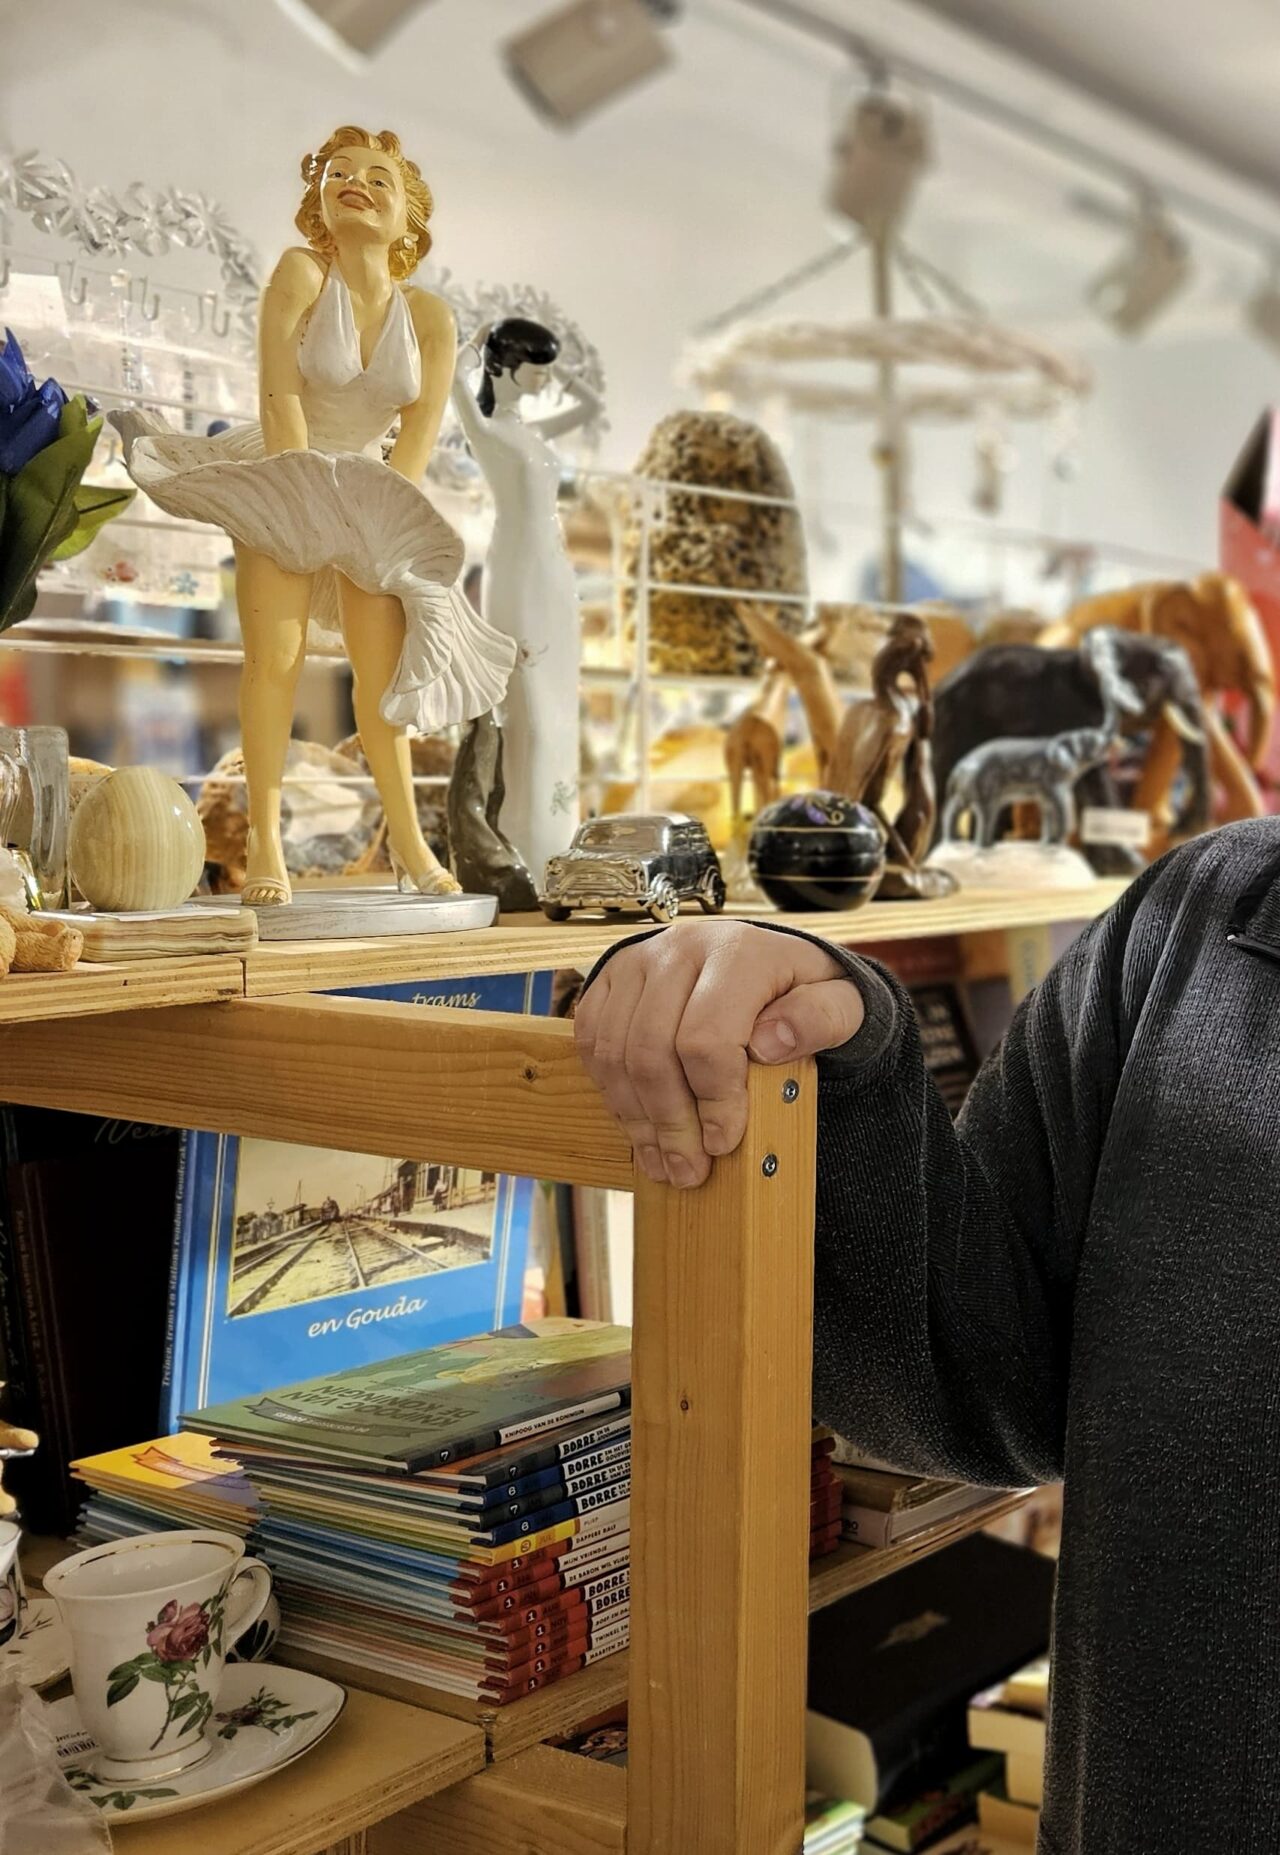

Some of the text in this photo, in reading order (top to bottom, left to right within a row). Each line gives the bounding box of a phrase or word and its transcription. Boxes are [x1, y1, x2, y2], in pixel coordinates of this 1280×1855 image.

[412, 992, 481, 1008] trams
[173, 1203, 183, 1245] rondom
[169, 1246, 179, 1289] stations
[166, 1309, 175, 1340] trams
[308, 1295, 428, 1339] en Gouda
[280, 1390, 339, 1408] VAN
[341, 1402, 457, 1428] KNIPOOG
[440, 1450, 449, 1461] 7
[504, 1426, 533, 1438] KNIPOOG
[534, 1421, 546, 1429] VAN
[509, 1466, 517, 1476] 7
[562, 1433, 595, 1455] BORRE
[568, 1453, 604, 1476] BORRE
[510, 1505, 518, 1514] 7
[571, 1471, 609, 1493] BORRE
[581, 1488, 617, 1510] BORRE
[498, 1545, 608, 1591] 1 MIJN VRIENDJE
[512, 1559, 519, 1569] 1
[505, 1598, 513, 1608] 1
[578, 1566, 600, 1579] BARON
[528, 1611, 535, 1622] 1
[588, 1573, 625, 1597] BORRE
[536, 1626, 544, 1636] 1
[596, 1586, 630, 1611] BORRE
[537, 1644, 544, 1654] 1
[529, 1679, 536, 1689] 1
[536, 1662, 544, 1672] 1
